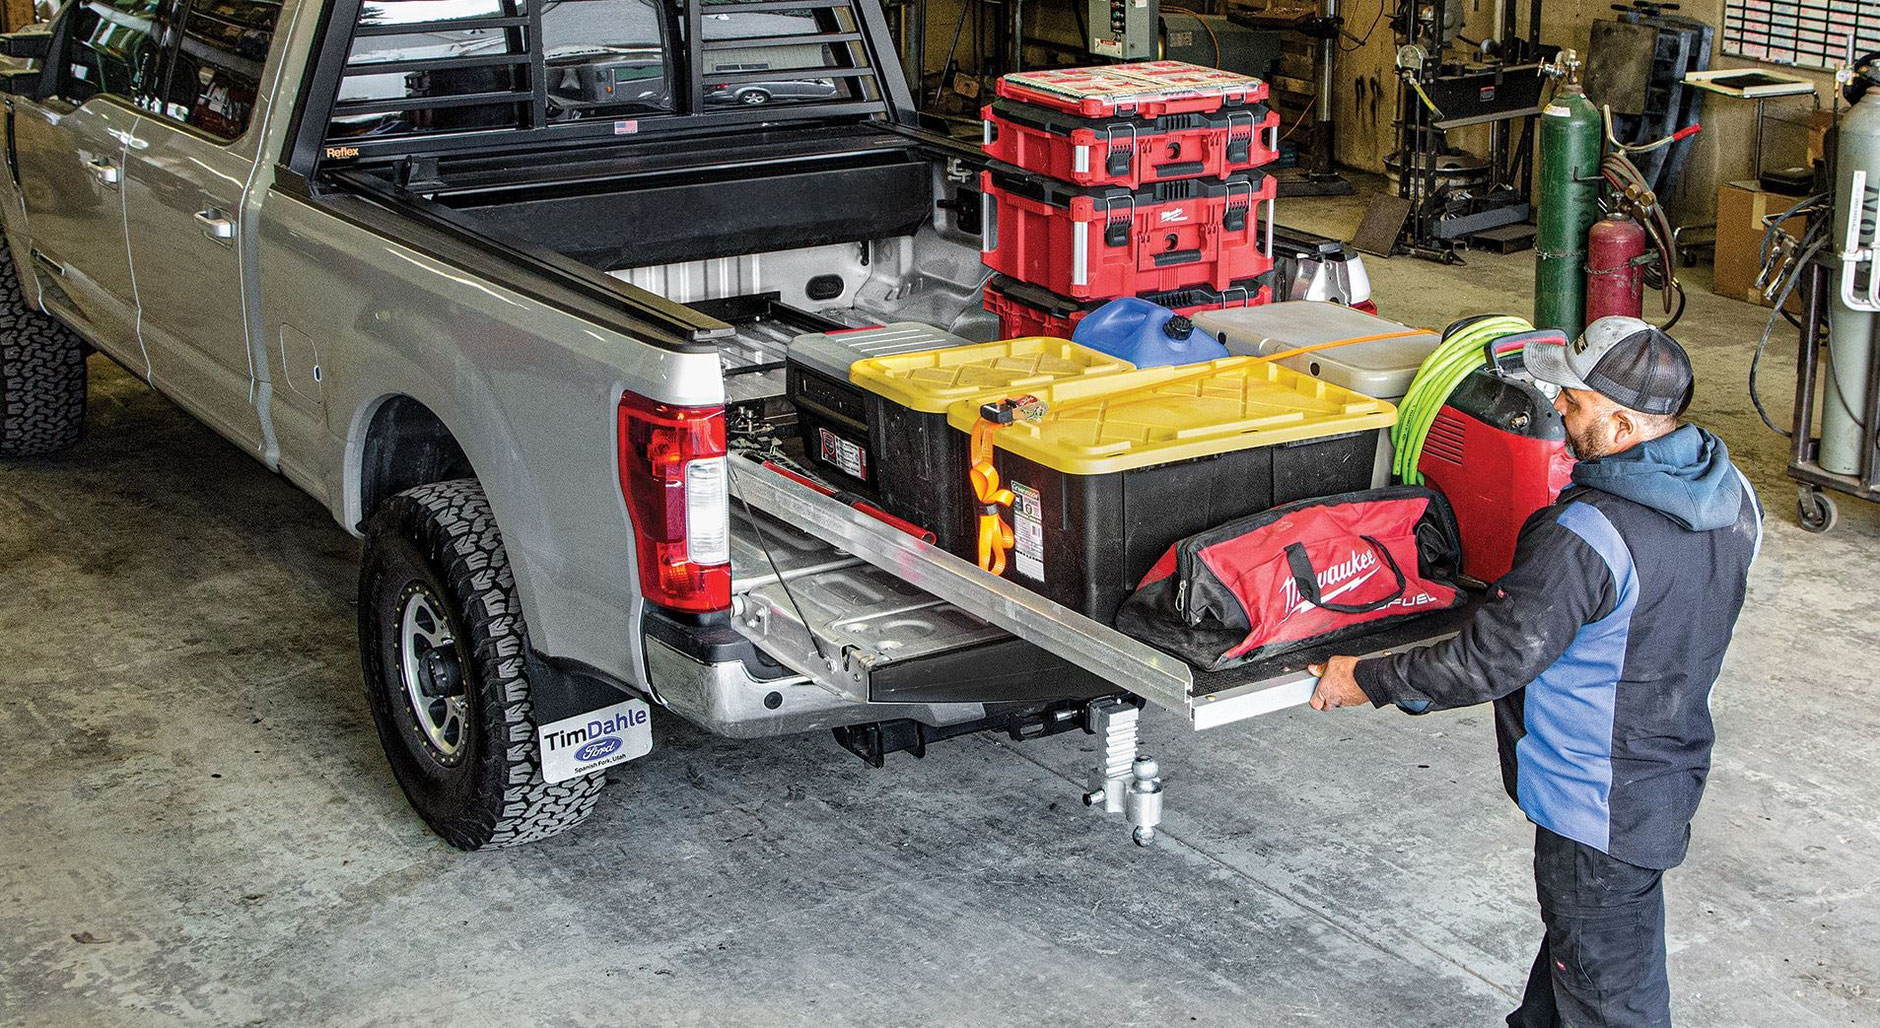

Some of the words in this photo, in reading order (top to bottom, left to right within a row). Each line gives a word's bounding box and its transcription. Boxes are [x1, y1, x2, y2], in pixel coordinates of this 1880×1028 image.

[326, 146, 359, 158] Reflex
[1279, 549, 1376, 613] Mwaukee
[582, 741, 616, 760] Ford
[574, 762, 598, 773] Spanish
